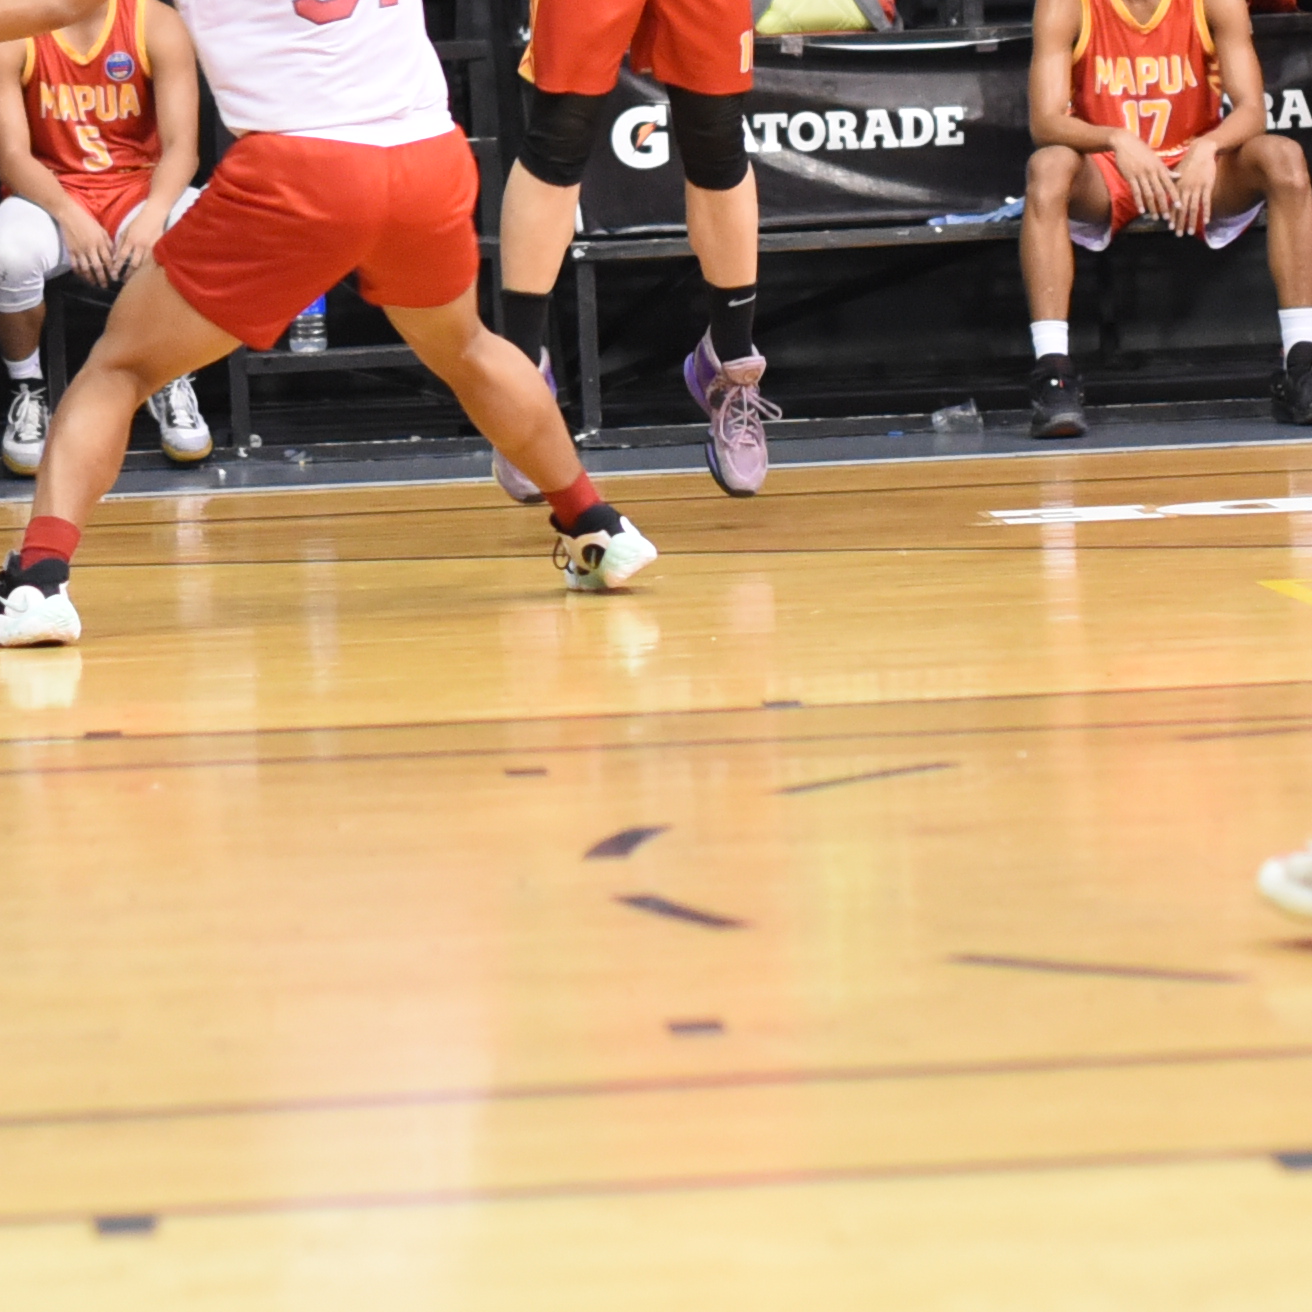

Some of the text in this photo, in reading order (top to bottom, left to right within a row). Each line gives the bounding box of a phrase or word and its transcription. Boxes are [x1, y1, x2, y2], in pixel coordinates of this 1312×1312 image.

[1094, 53, 1198, 96] MAPUA
[39, 81, 141, 122] MAPUA
[1122, 98, 1172, 149] 17
[74, 125, 114, 172] 5
